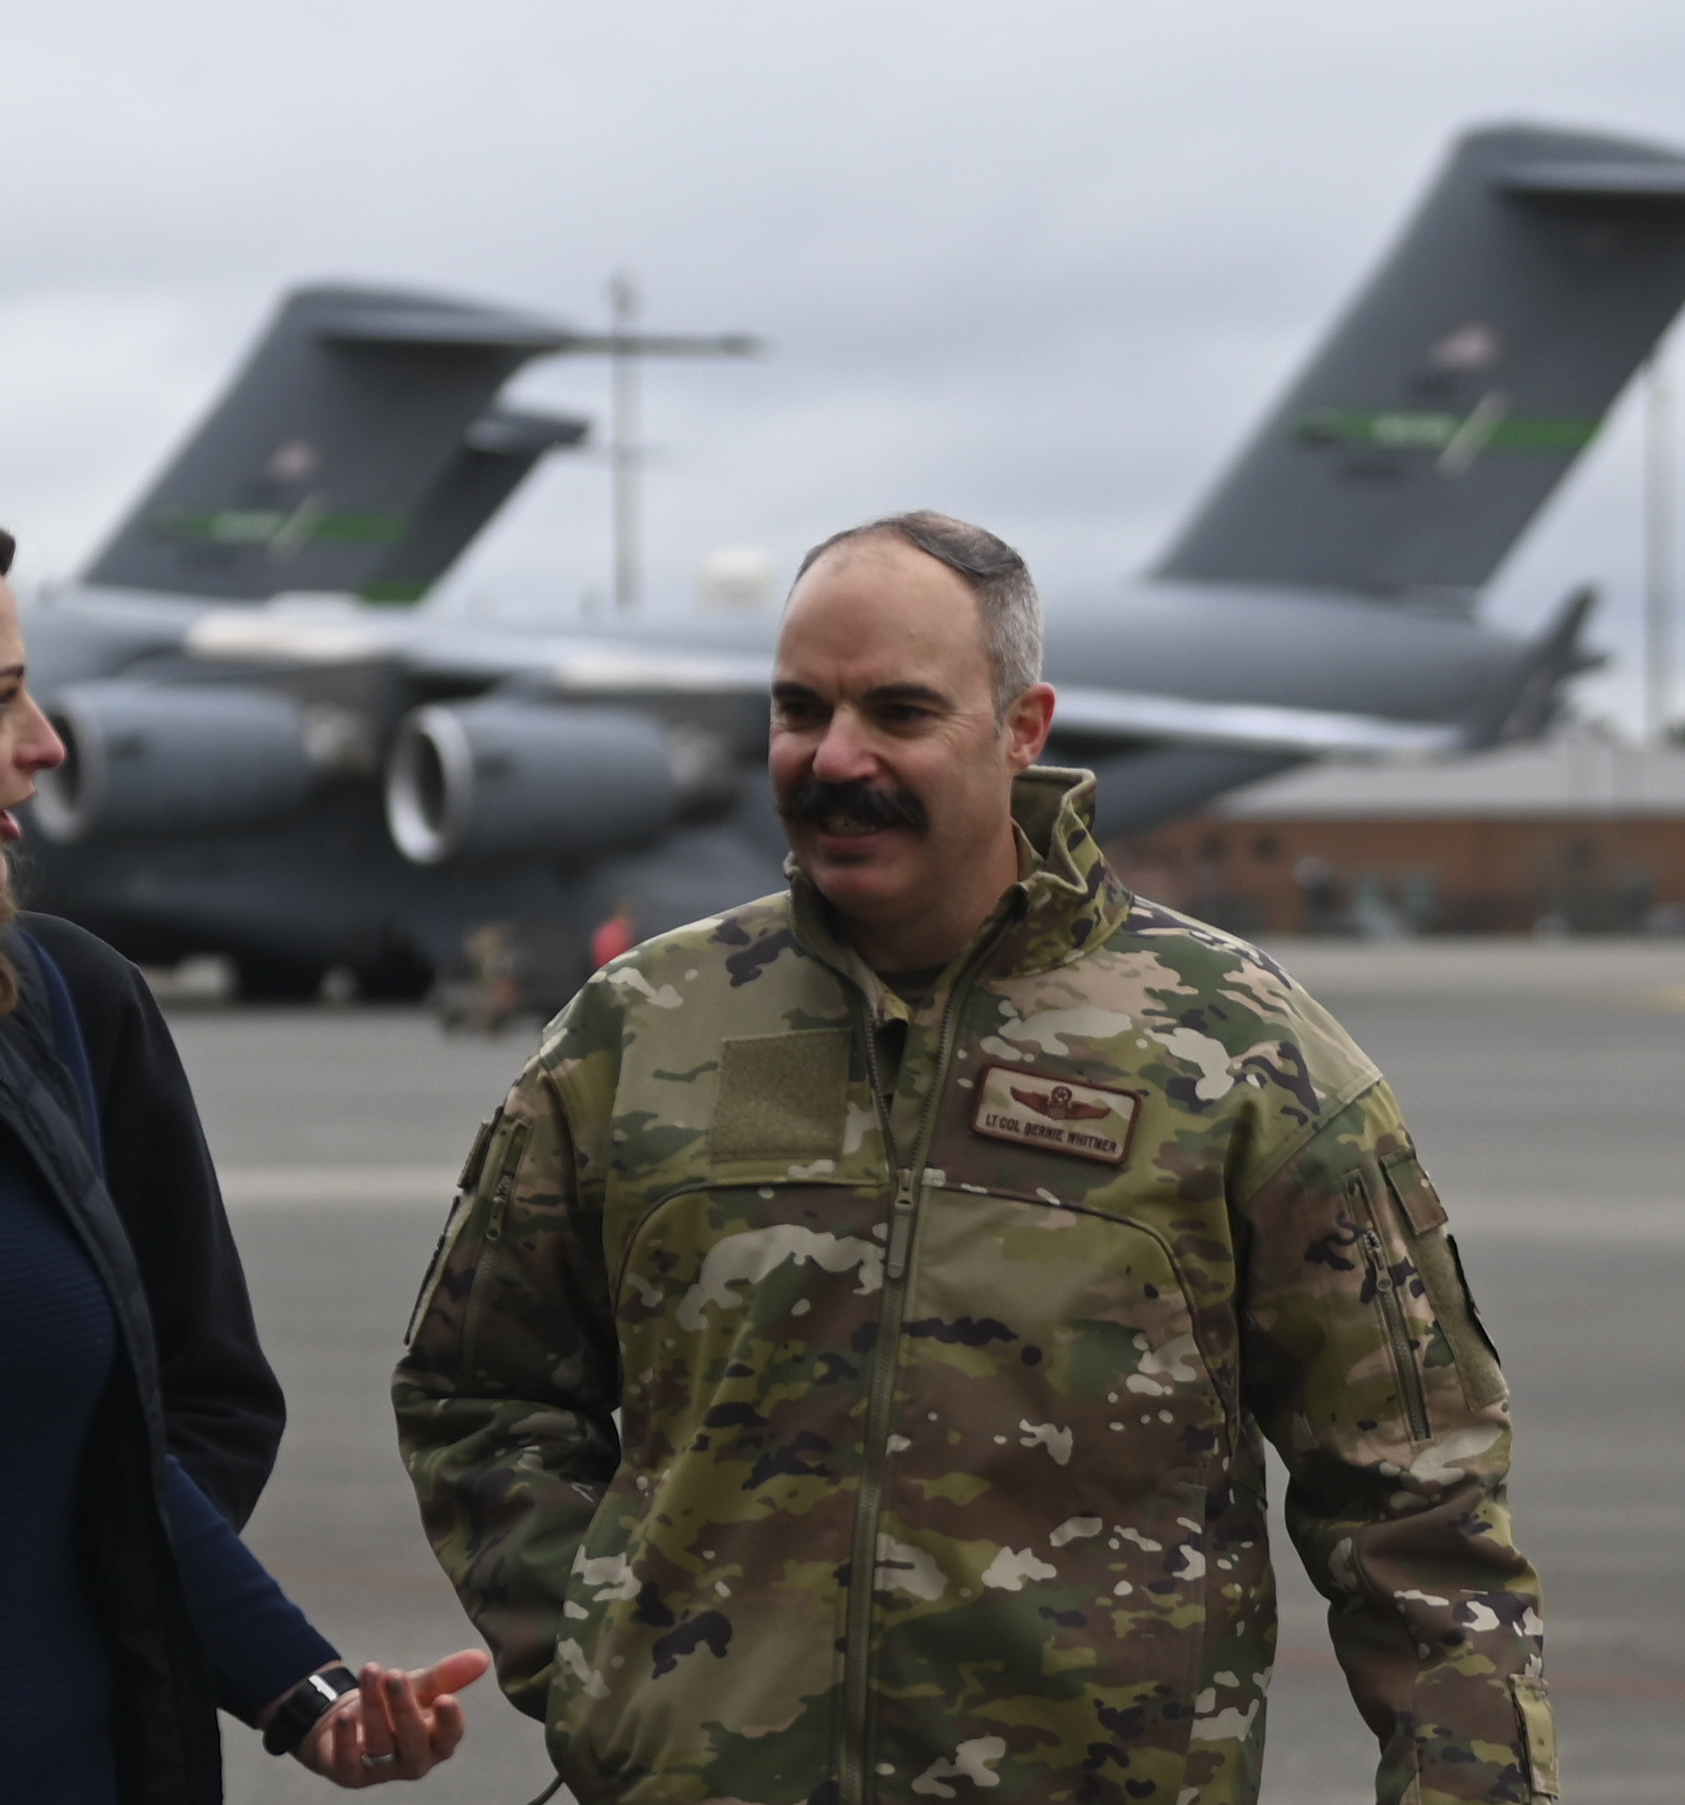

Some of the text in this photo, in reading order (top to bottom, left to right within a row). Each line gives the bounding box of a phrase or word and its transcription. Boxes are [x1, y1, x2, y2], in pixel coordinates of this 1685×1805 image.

[985, 1113, 998, 1127] LT
[999, 1116, 1020, 1133] COL
[1023, 1121, 1065, 1142] BERNIE
